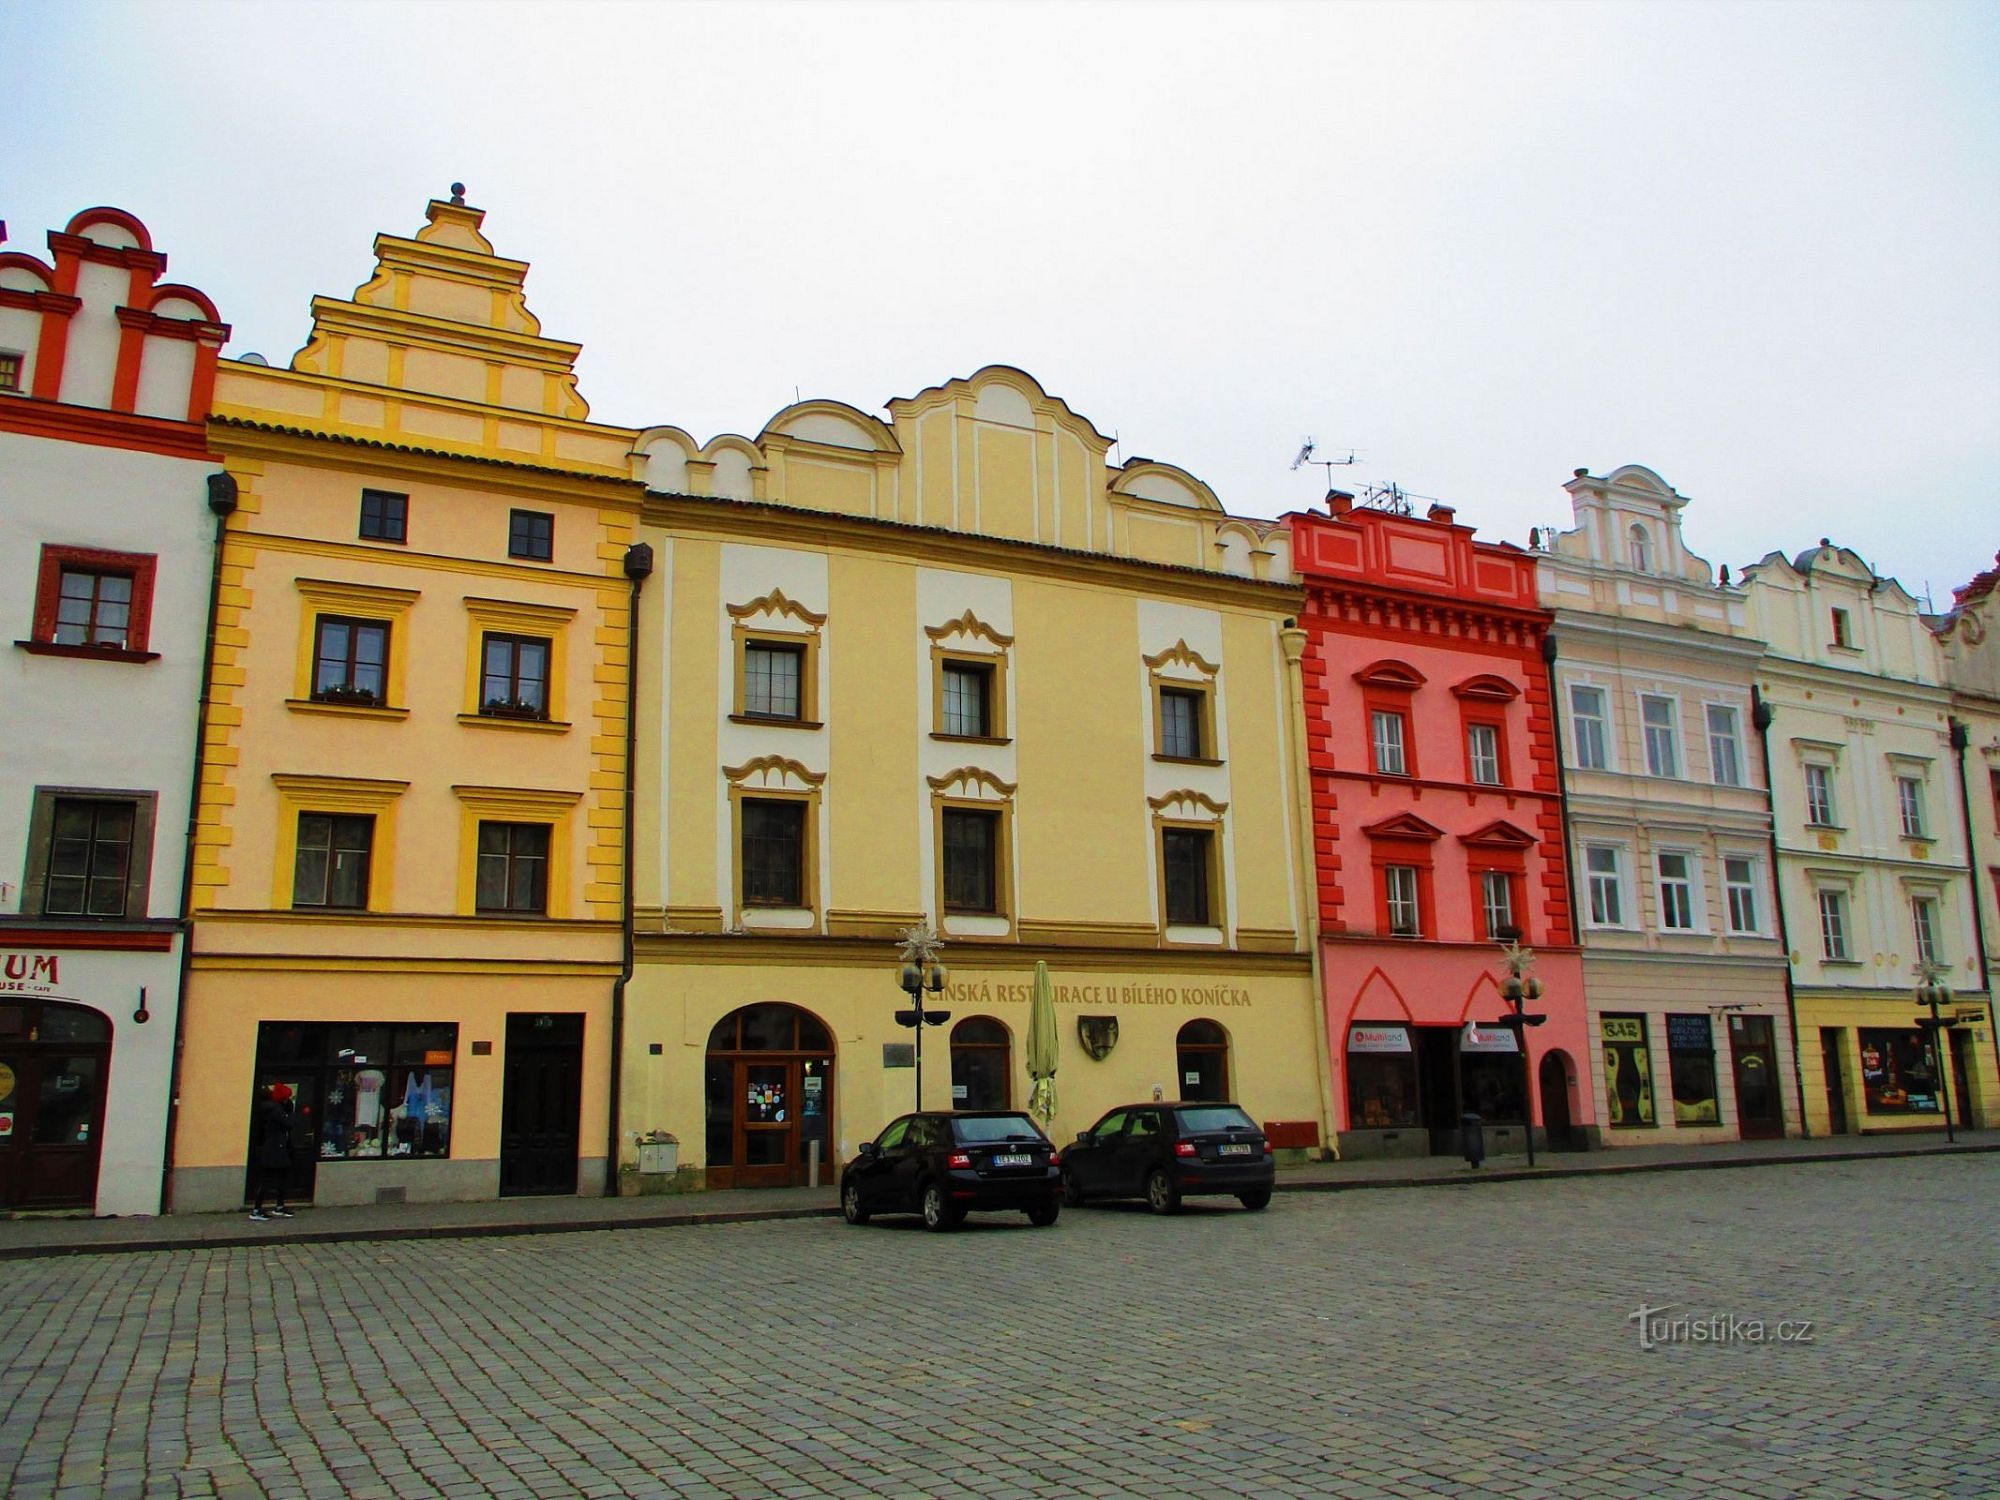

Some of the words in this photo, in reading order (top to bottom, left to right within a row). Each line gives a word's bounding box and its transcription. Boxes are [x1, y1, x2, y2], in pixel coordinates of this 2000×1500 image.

[0, 954, 59, 985] UM
[997, 984, 1102, 1004] RESTRACE
[1122, 983, 1178, 1005] BÍLÉHO
[1181, 985, 1252, 1007] KONÍČKA
[1364, 1032, 1403, 1042] Multiland
